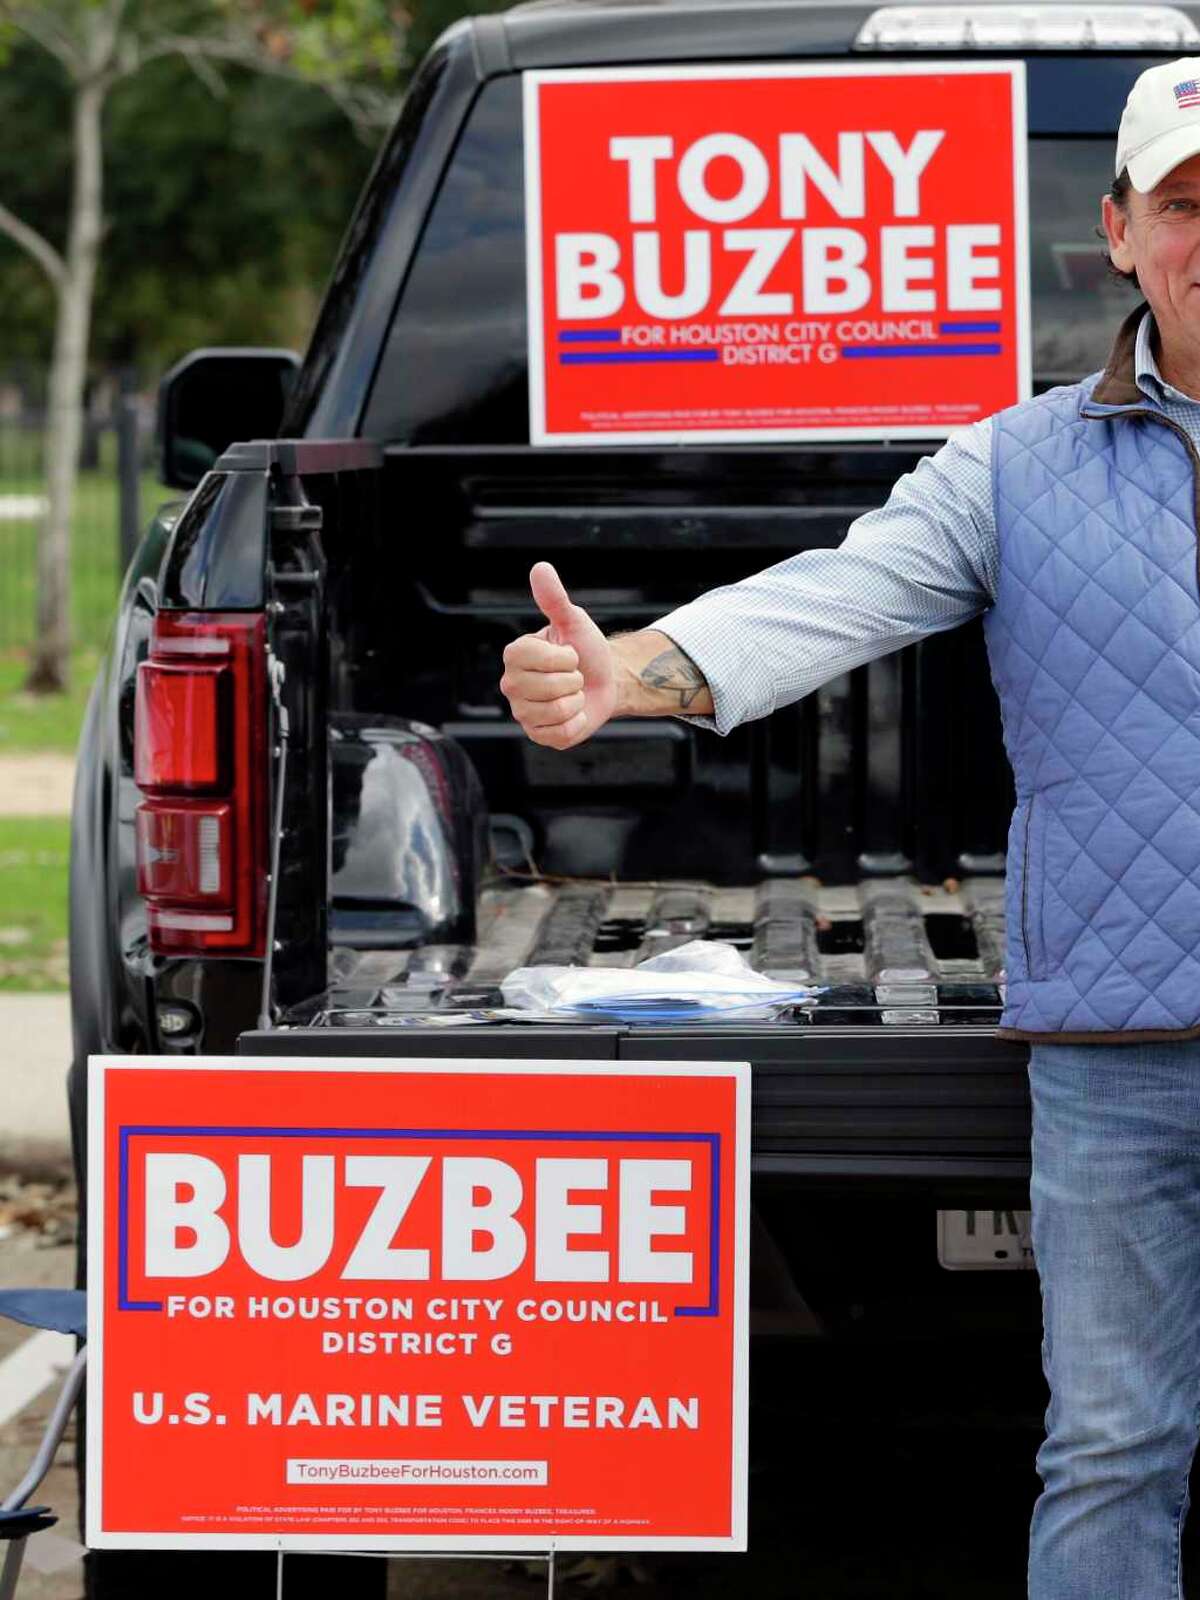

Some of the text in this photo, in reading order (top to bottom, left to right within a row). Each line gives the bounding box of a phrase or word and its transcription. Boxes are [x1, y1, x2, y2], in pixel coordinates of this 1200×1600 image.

[609, 130, 945, 223] TONY
[555, 224, 1002, 320] BUZBEE
[621, 319, 937, 346] FOR HOUSTON CITY COUNCIL
[722, 342, 837, 366] DISTRICT G
[144, 1152, 694, 1284] BUZBEE
[167, 1295, 668, 1323] FOR HOUSTON CITY COUNCIL
[322, 1331, 512, 1356] DISTRICT G
[132, 1392, 699, 1429] U.S. MARINE VETERAN
[297, 1463, 538, 1480] TonyBuzbeeForHouston.com
